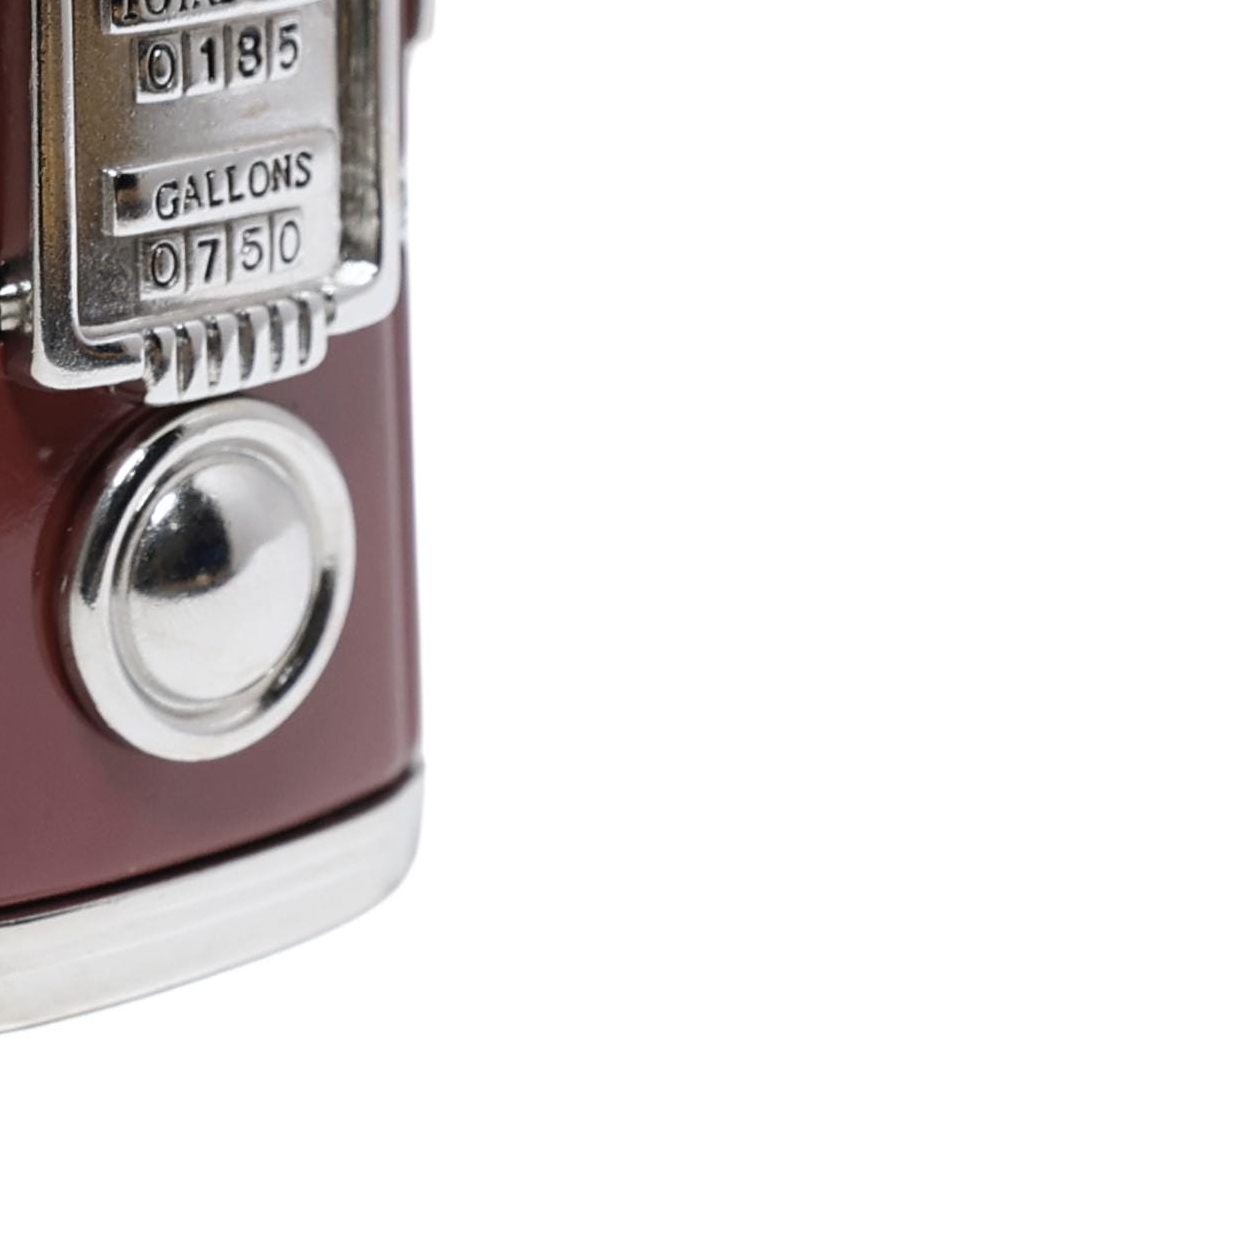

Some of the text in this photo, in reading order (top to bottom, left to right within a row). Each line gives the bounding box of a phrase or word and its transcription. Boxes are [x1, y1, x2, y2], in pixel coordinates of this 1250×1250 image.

[146, 23, 299, 94] 0185
[155, 151, 313, 221] GALLONS
[150, 220, 300, 287] 0750
